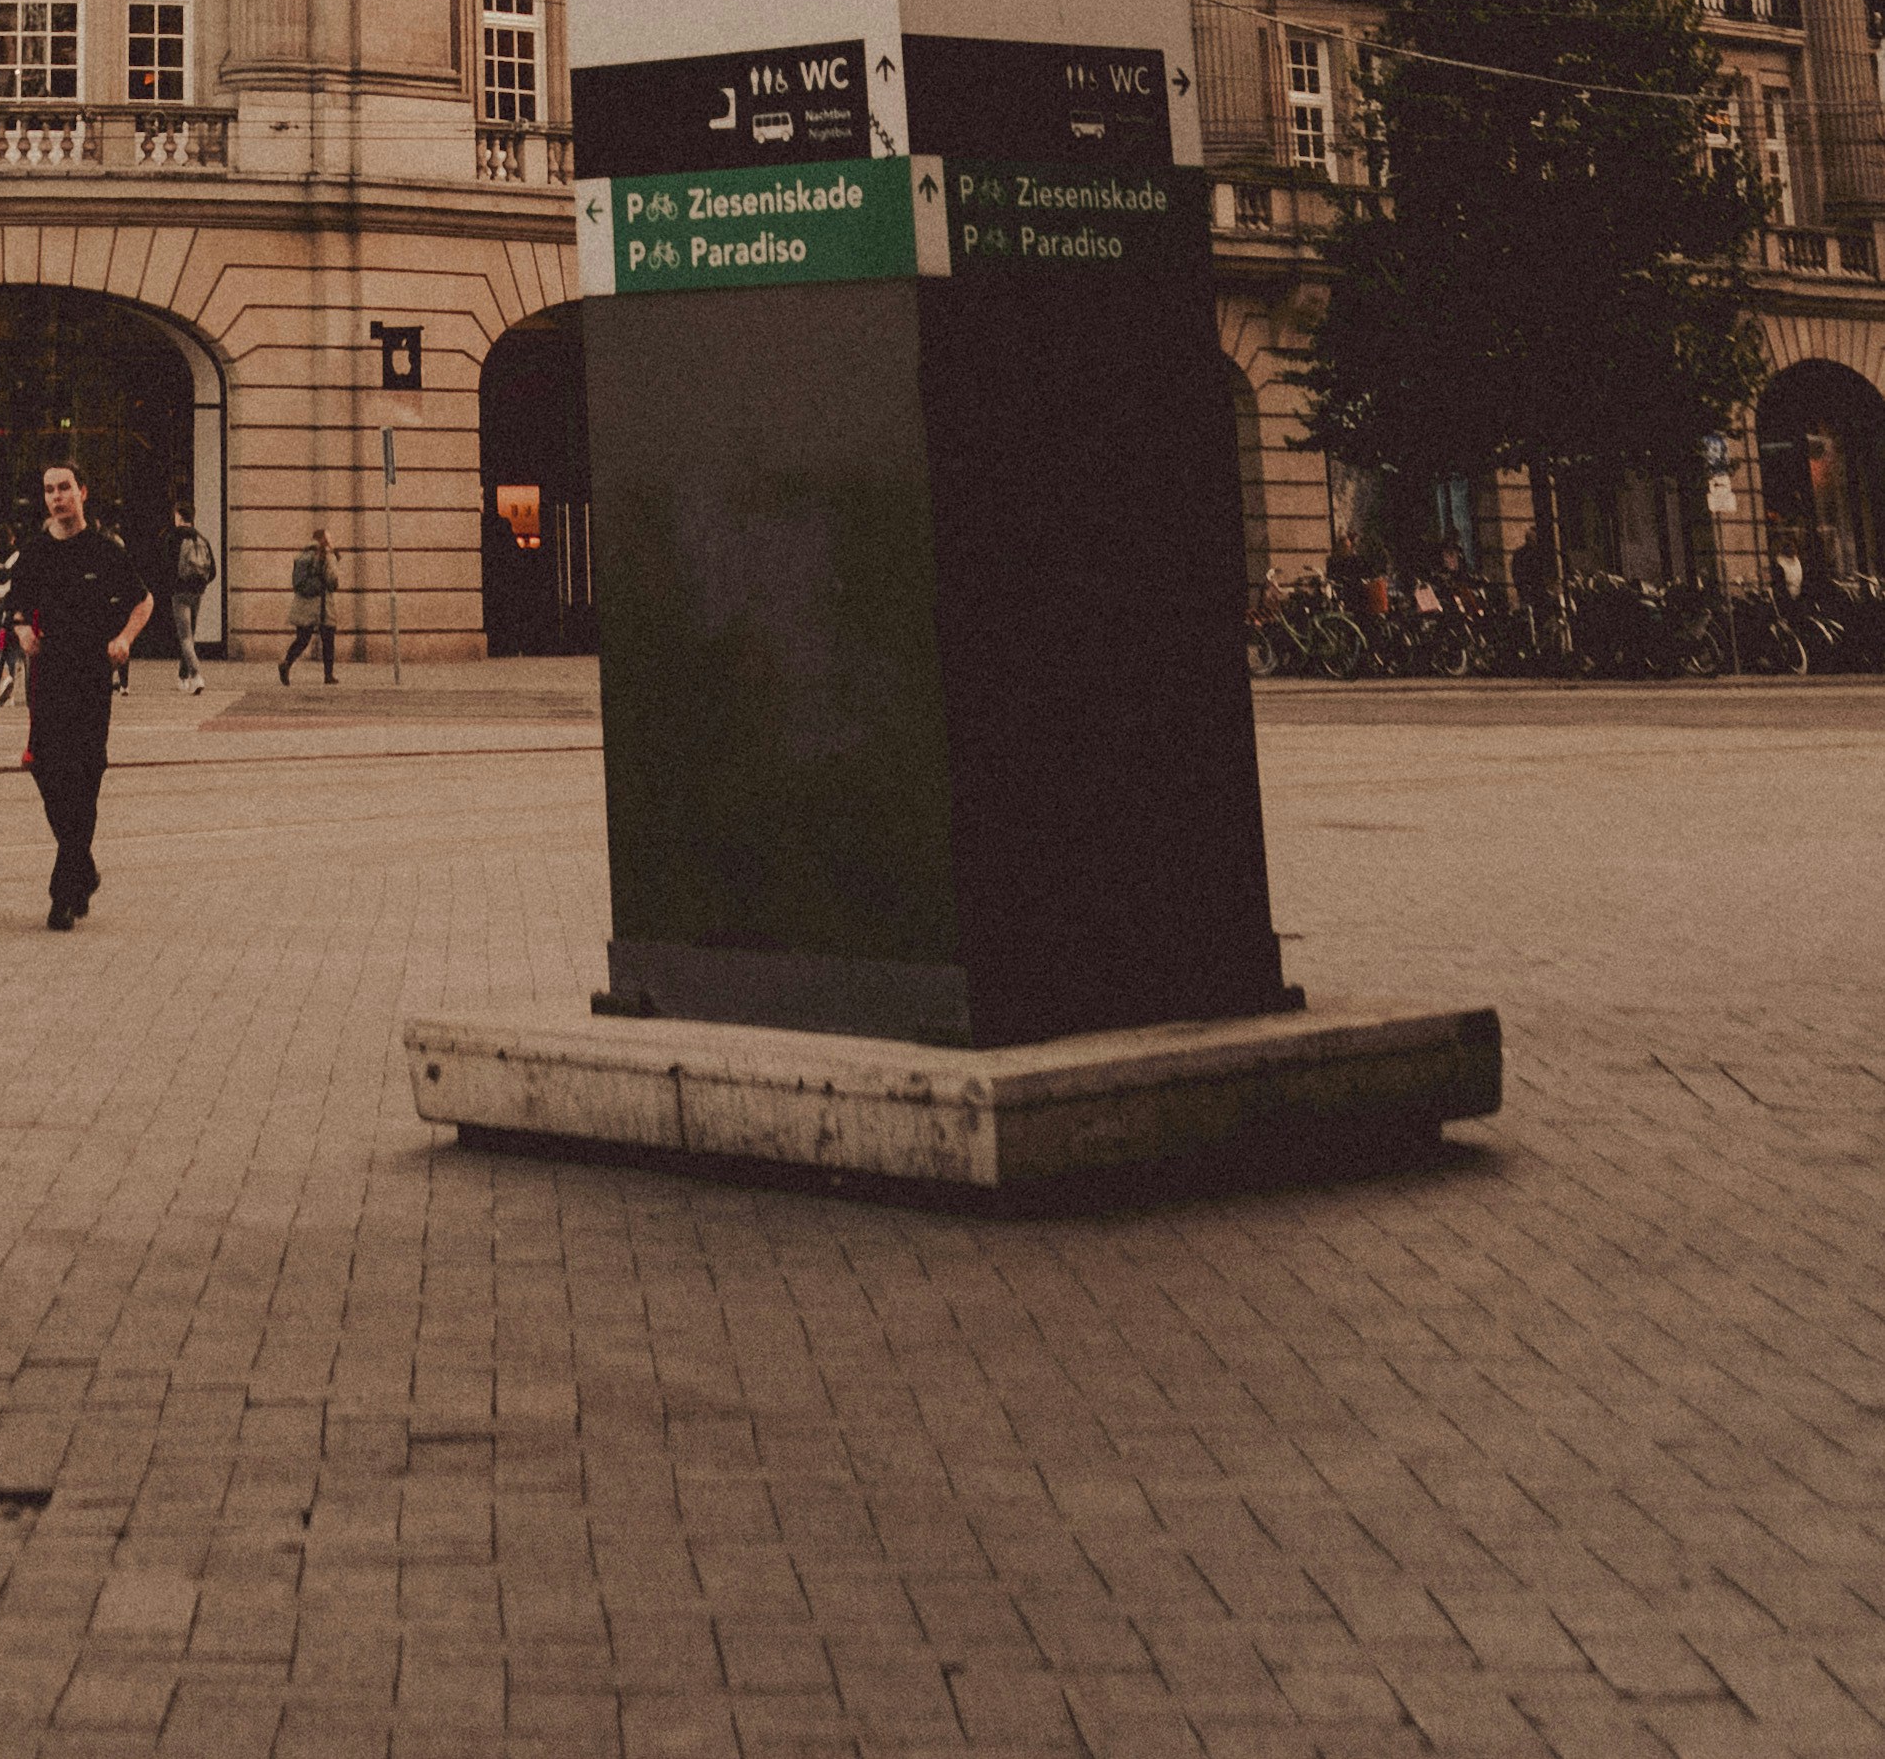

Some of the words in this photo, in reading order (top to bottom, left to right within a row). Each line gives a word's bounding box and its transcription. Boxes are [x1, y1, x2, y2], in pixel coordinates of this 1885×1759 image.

[799, 56, 850, 92] WC
[1109, 64, 1151, 95] WC
[627, 191, 644, 224] P
[687, 174, 864, 221] Zieseniskade
[959, 174, 975, 205] P
[1015, 175, 1168, 212] Zieseniskade
[628, 239, 646, 272] P
[690, 231, 808, 269] Paradiso
[963, 224, 979, 255] P
[1020, 224, 1124, 259] Paradiso
